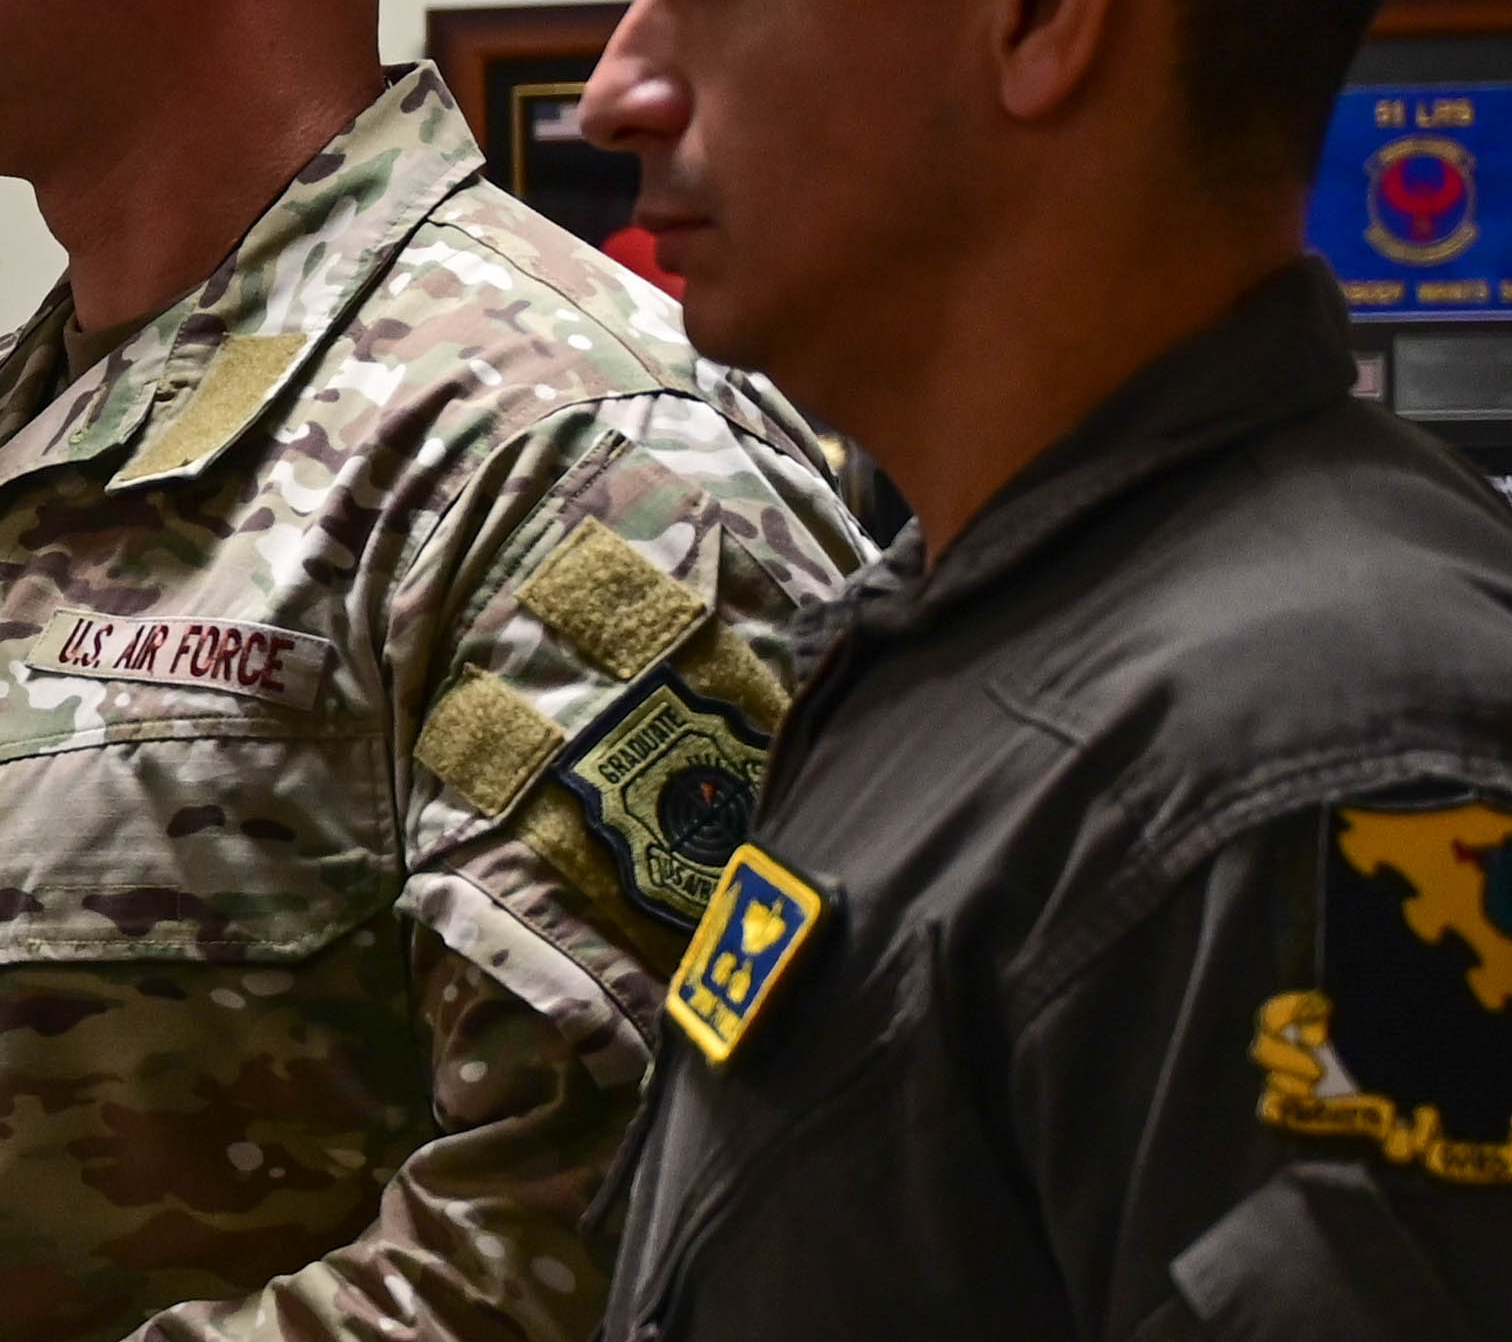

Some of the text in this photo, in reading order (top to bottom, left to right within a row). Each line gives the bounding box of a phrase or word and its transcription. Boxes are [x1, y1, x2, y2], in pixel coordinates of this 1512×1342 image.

[58, 618, 295, 693] U.S. AIR FORCE
